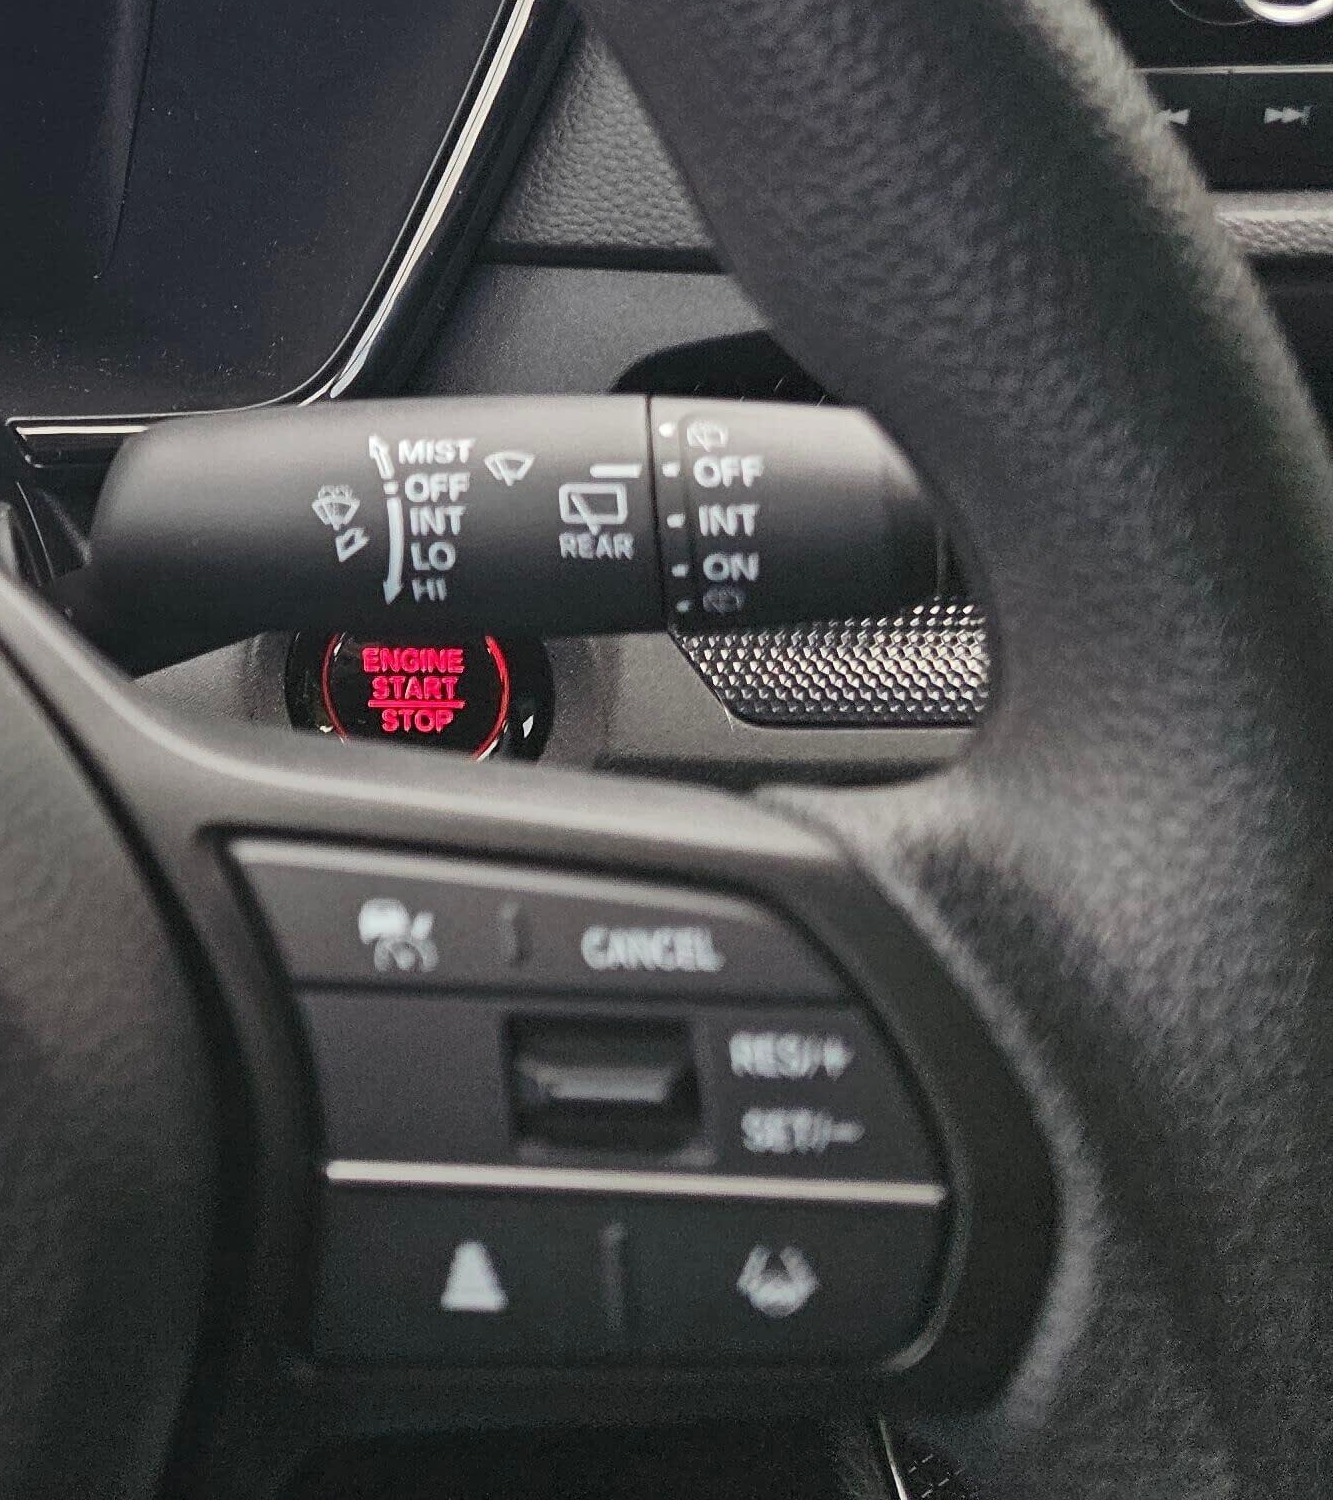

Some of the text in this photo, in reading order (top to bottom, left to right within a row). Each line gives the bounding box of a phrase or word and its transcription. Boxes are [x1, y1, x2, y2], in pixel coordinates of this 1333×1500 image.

[397, 438, 477, 464] MIST
[693, 454, 764, 488] OFF
[405, 472, 470, 503] OFF
[410, 505, 467, 536] INT
[699, 503, 761, 537] INT
[412, 542, 456, 571] LO
[558, 532, 634, 561] REAR
[702, 552, 760, 581] ON
[413, 574, 447, 602] HI
[363, 647, 464, 674] ENGINE
[371, 676, 459, 701] START
[380, 707, 454, 733] STOP
[581, 924, 725, 972] CANCEL
